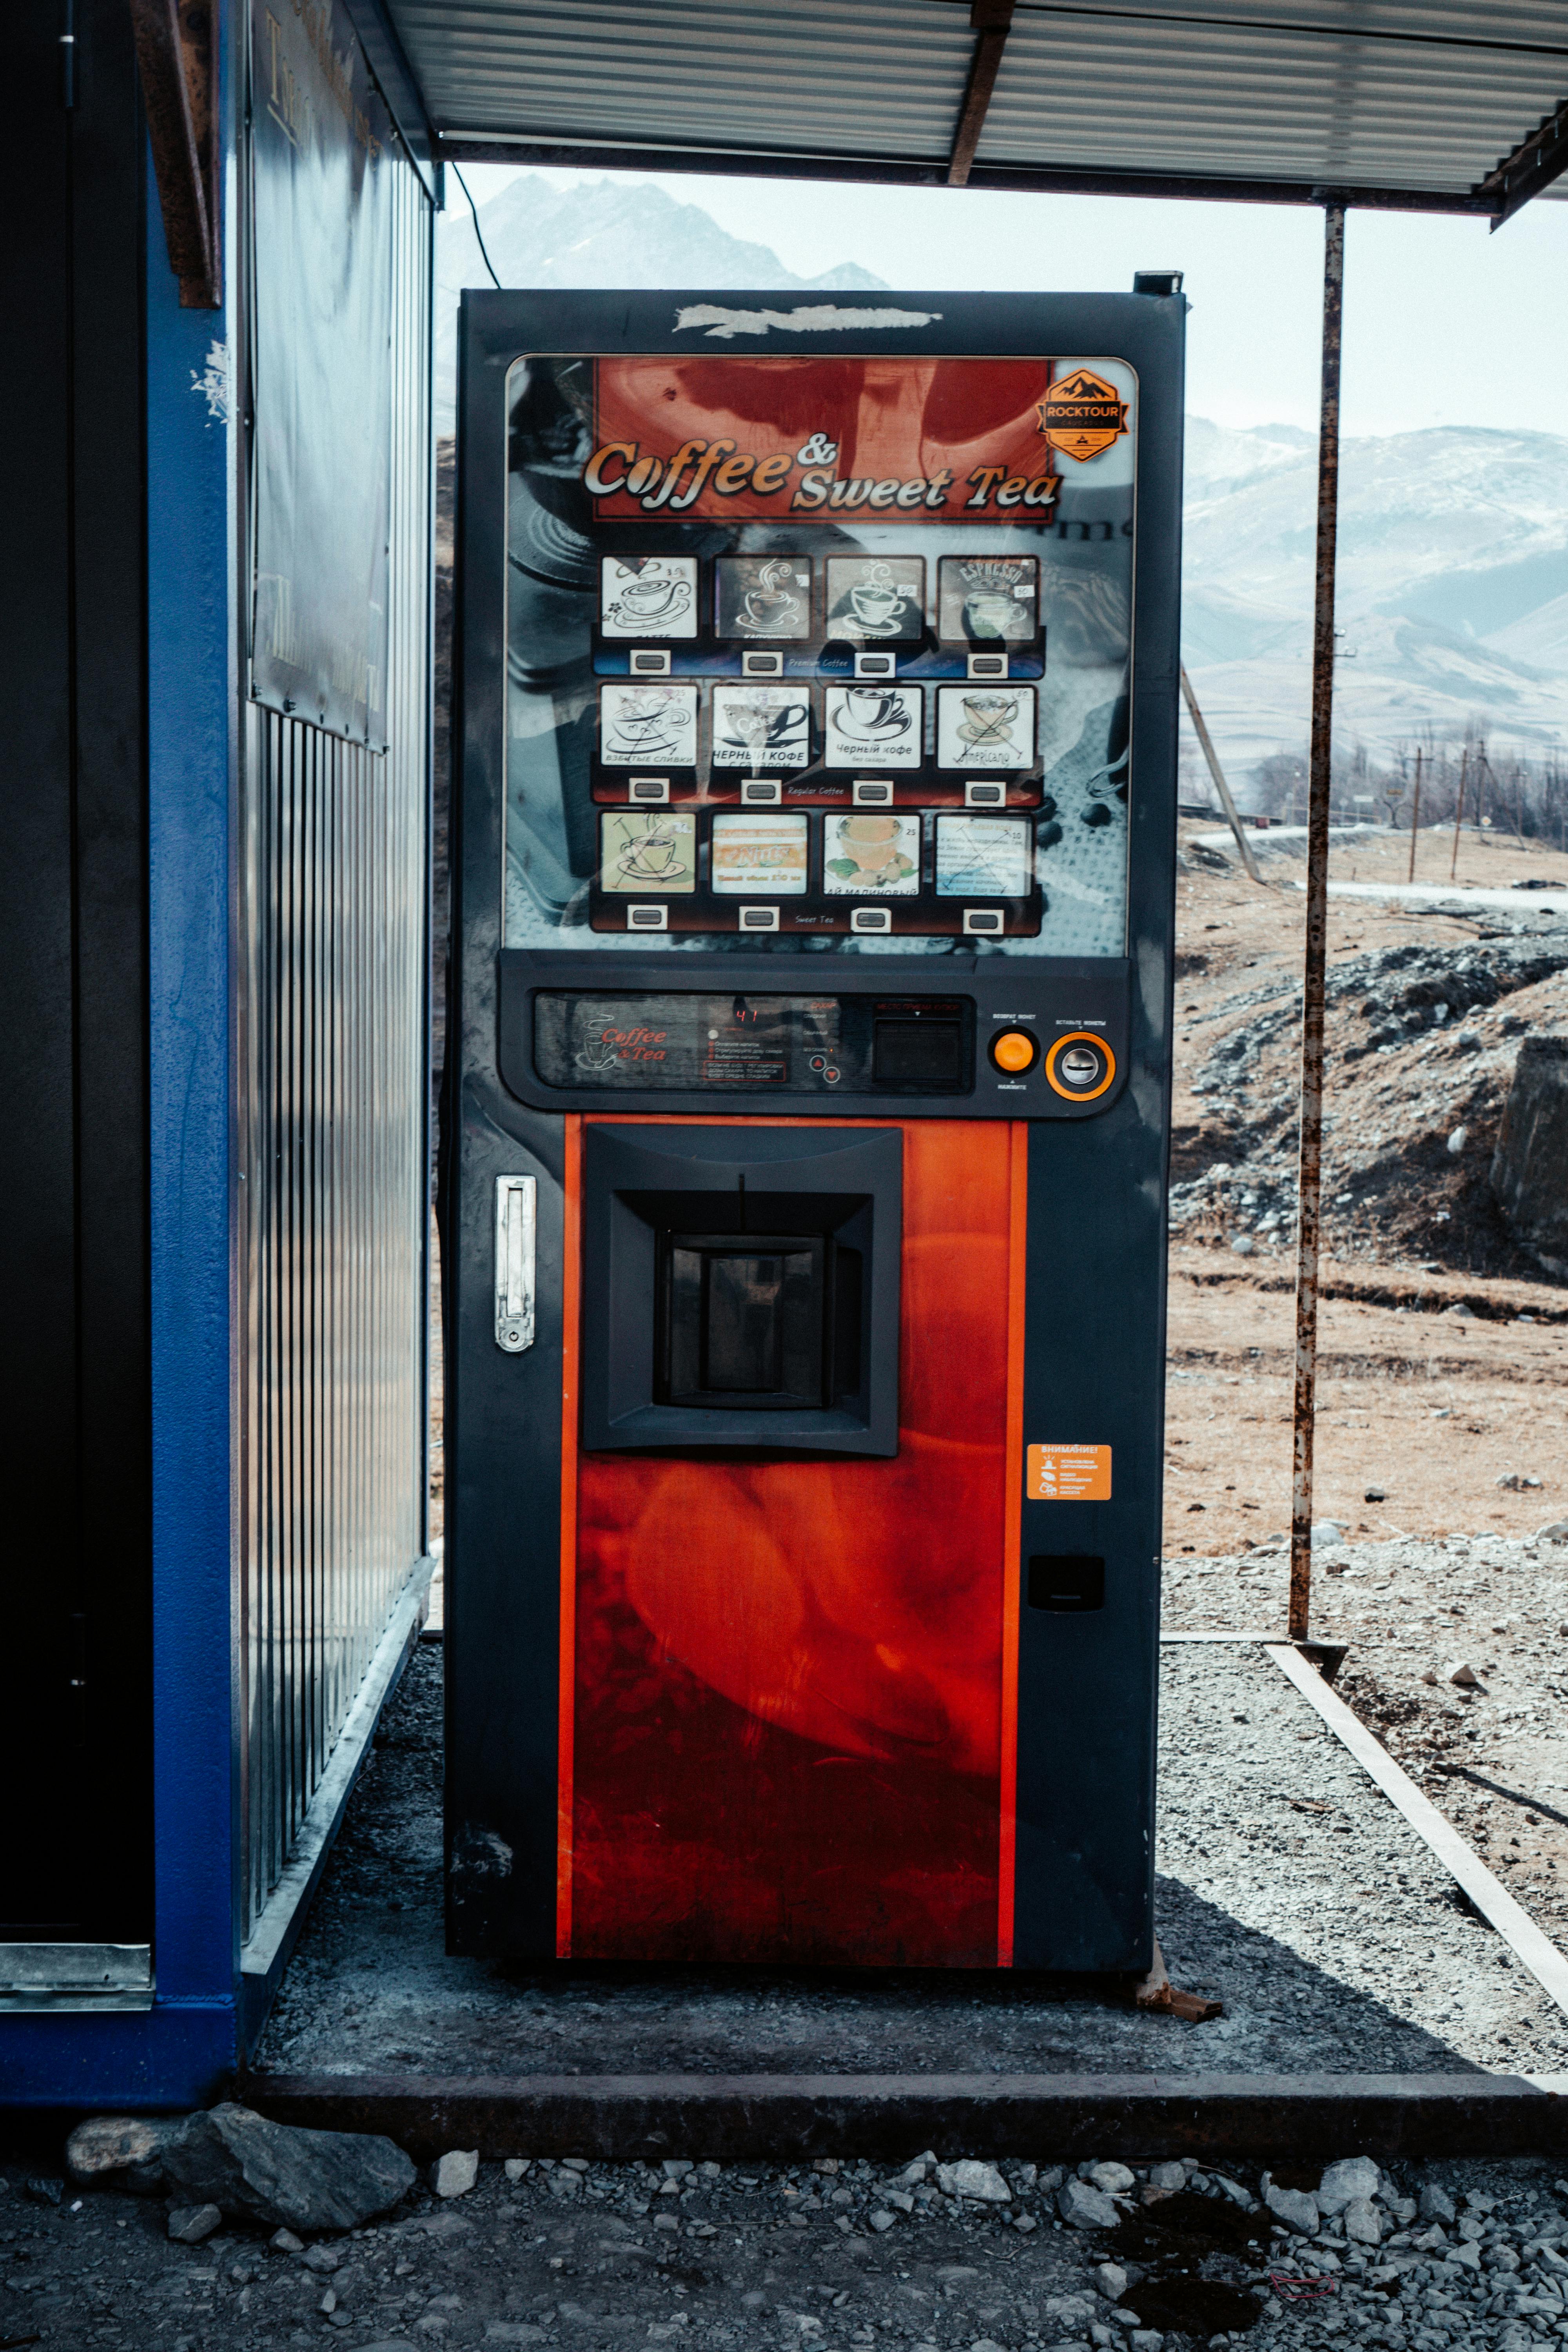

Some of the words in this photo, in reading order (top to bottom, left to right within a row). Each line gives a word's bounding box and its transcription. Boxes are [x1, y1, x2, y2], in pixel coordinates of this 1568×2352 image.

[1047, 407, 1119, 417] ROCKTOUR
[797, 432, 839, 466] &
[584, 438, 794, 511] Coffee
[792, 469, 953, 510] Sweet
[966, 465, 1063, 509] Tea
[959, 562, 1024, 584] ESPRESSO
[789, 658, 821, 666] Premium
[823, 659, 849, 668] Coffee
[769, 751, 805, 761] КОФЕ
[836, 744, 880, 755] Черный
[883, 745, 913, 756] кофе
[788, 786, 817, 797] Regular
[818, 787, 844, 796] Coffee
[820, 915, 834, 924] Tea
[601, 1027, 667, 1047] Coffee
[618, 1049, 630, 1058] &
[632, 1047, 666, 1060] Tea
